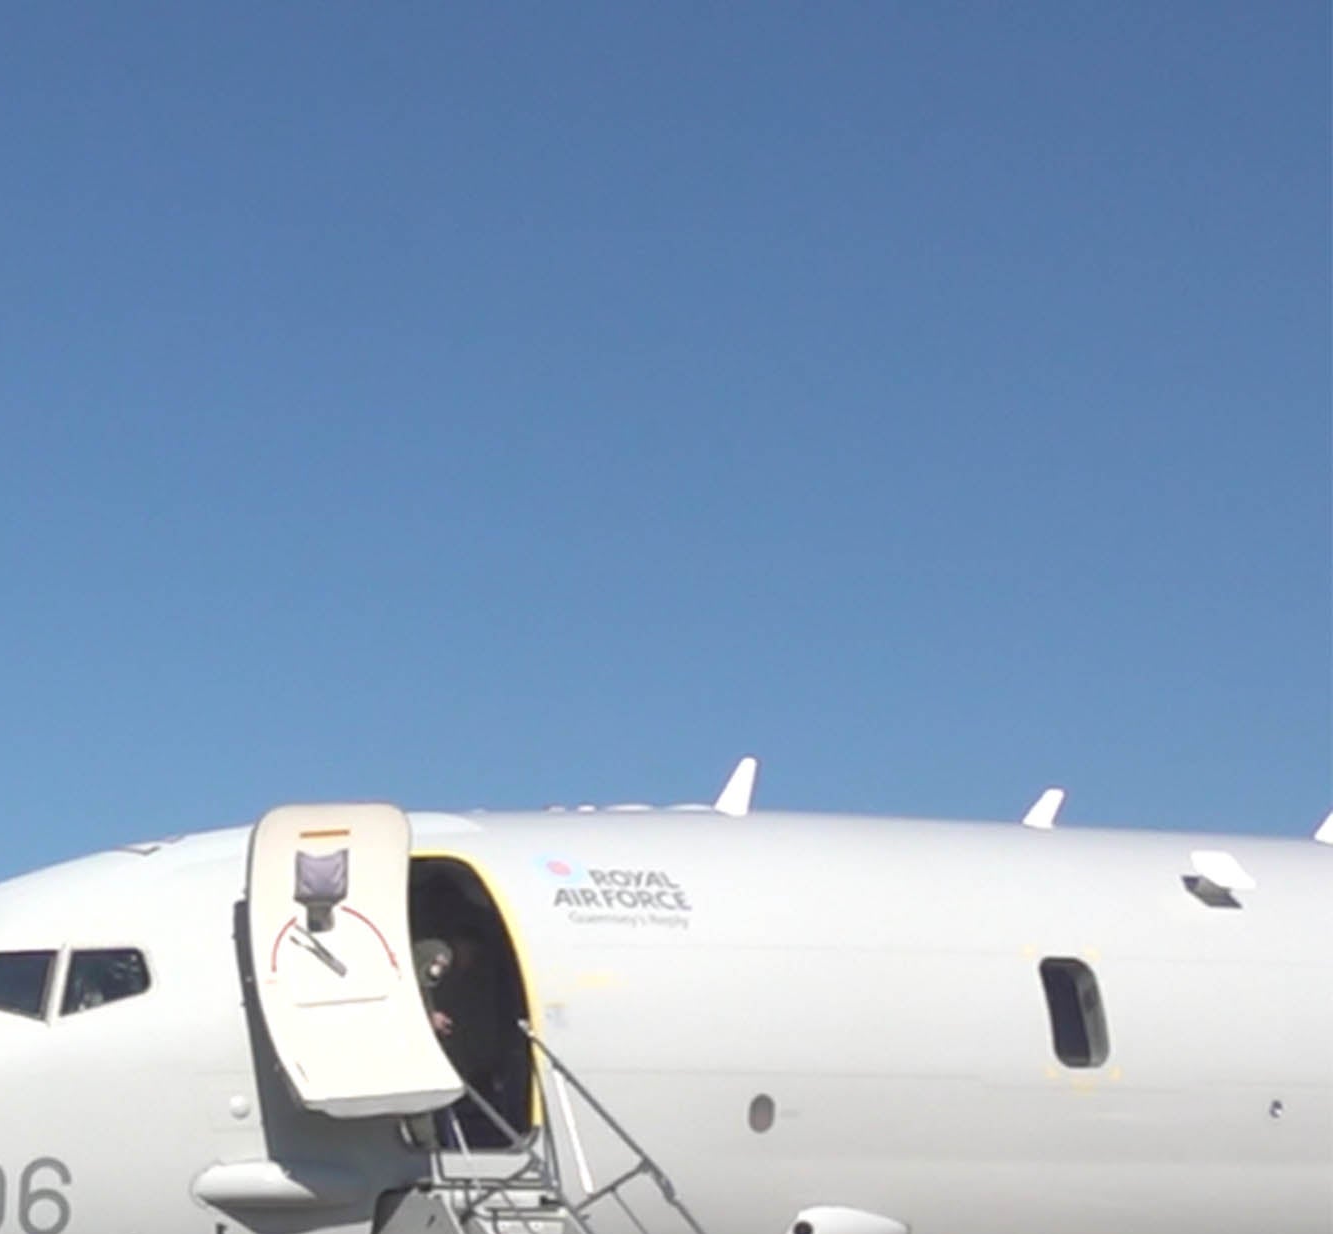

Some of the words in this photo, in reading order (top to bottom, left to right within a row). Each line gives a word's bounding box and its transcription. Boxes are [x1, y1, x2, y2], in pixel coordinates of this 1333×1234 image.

[588, 869, 680, 889] ROYAL
[553, 888, 602, 907] AIR
[601, 889, 692, 910] FORCE
